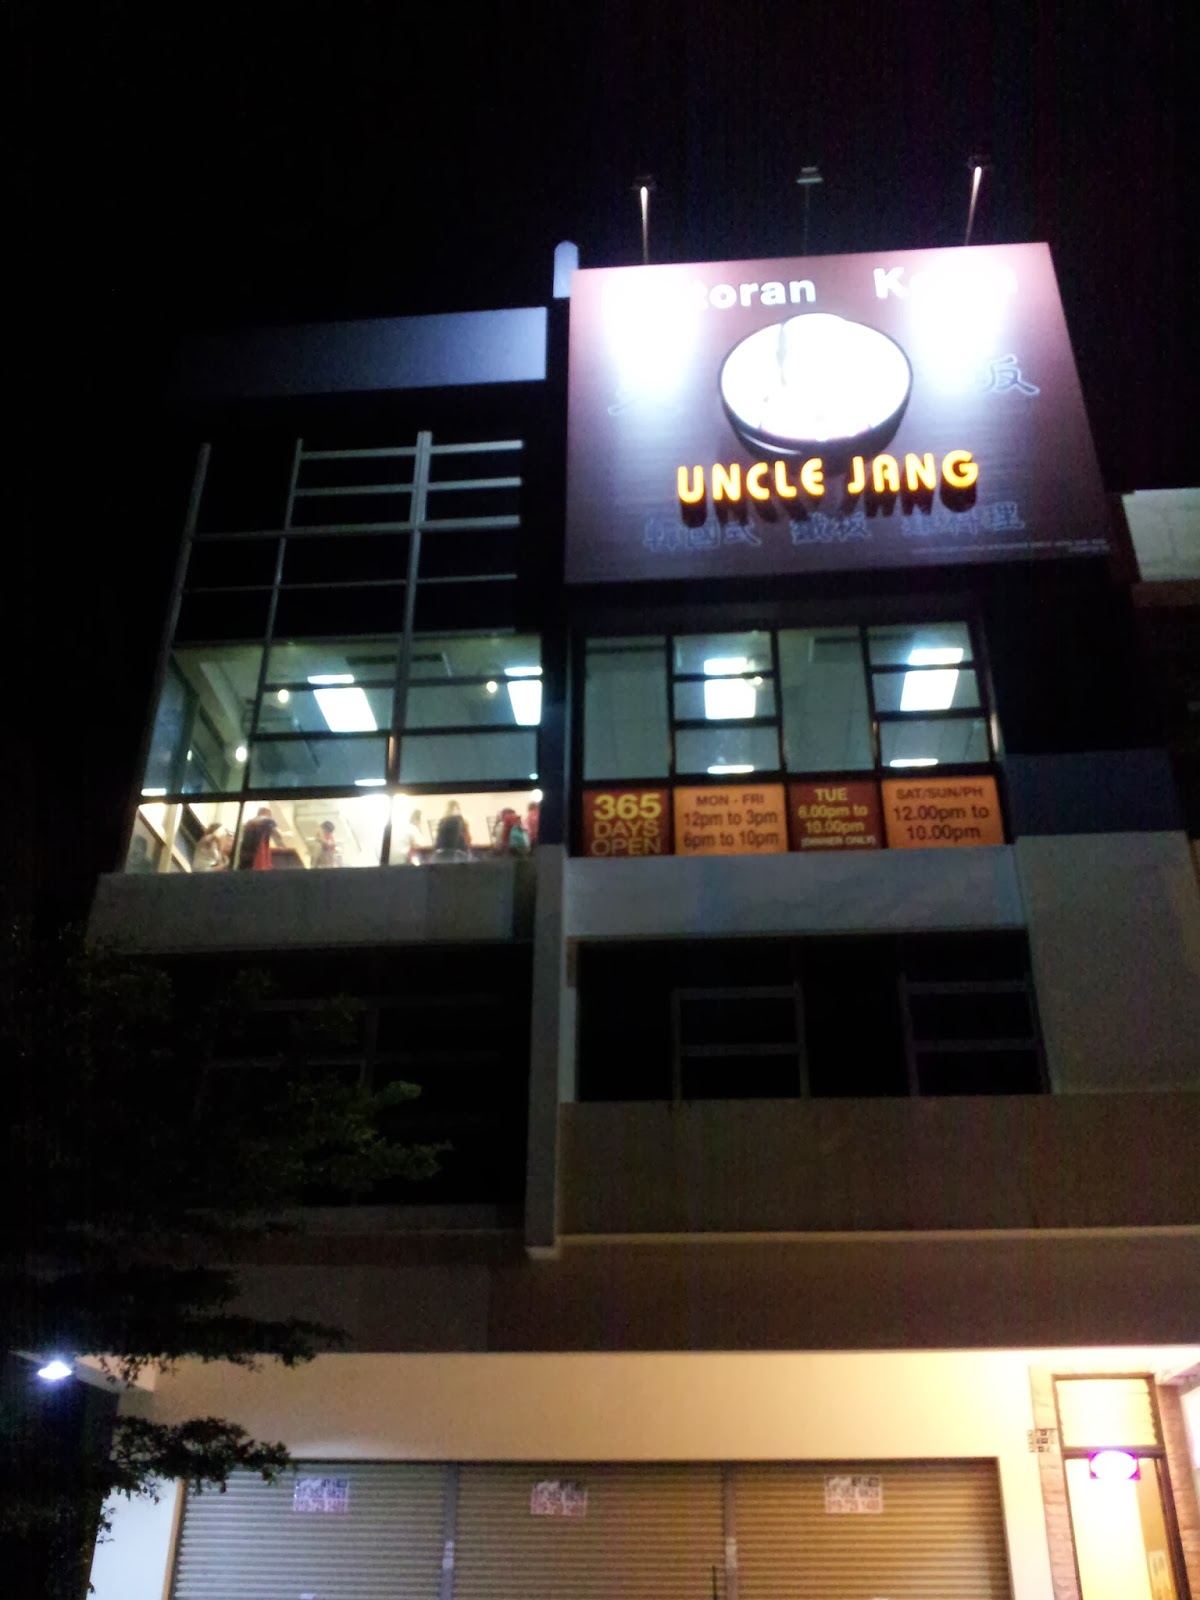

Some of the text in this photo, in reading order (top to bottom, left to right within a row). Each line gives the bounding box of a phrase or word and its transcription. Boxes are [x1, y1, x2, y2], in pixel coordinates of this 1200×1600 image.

[677, 449, 979, 503] UNCLE JANG
[696, 793, 729, 806] MON
[742, 792, 765, 804] FRI
[814, 786, 848, 802] TUE
[593, 792, 661, 820] 365
[853, 803, 869, 817] to
[893, 803, 990, 823] 12.00pm to
[593, 819, 660, 838] DAYS
[685, 809, 778, 829] 12pm to 3pm
[683, 829, 780, 850] 6pm to 10pm
[907, 823, 982, 843] 10.00pm
[591, 837, 662, 856] OPEN
